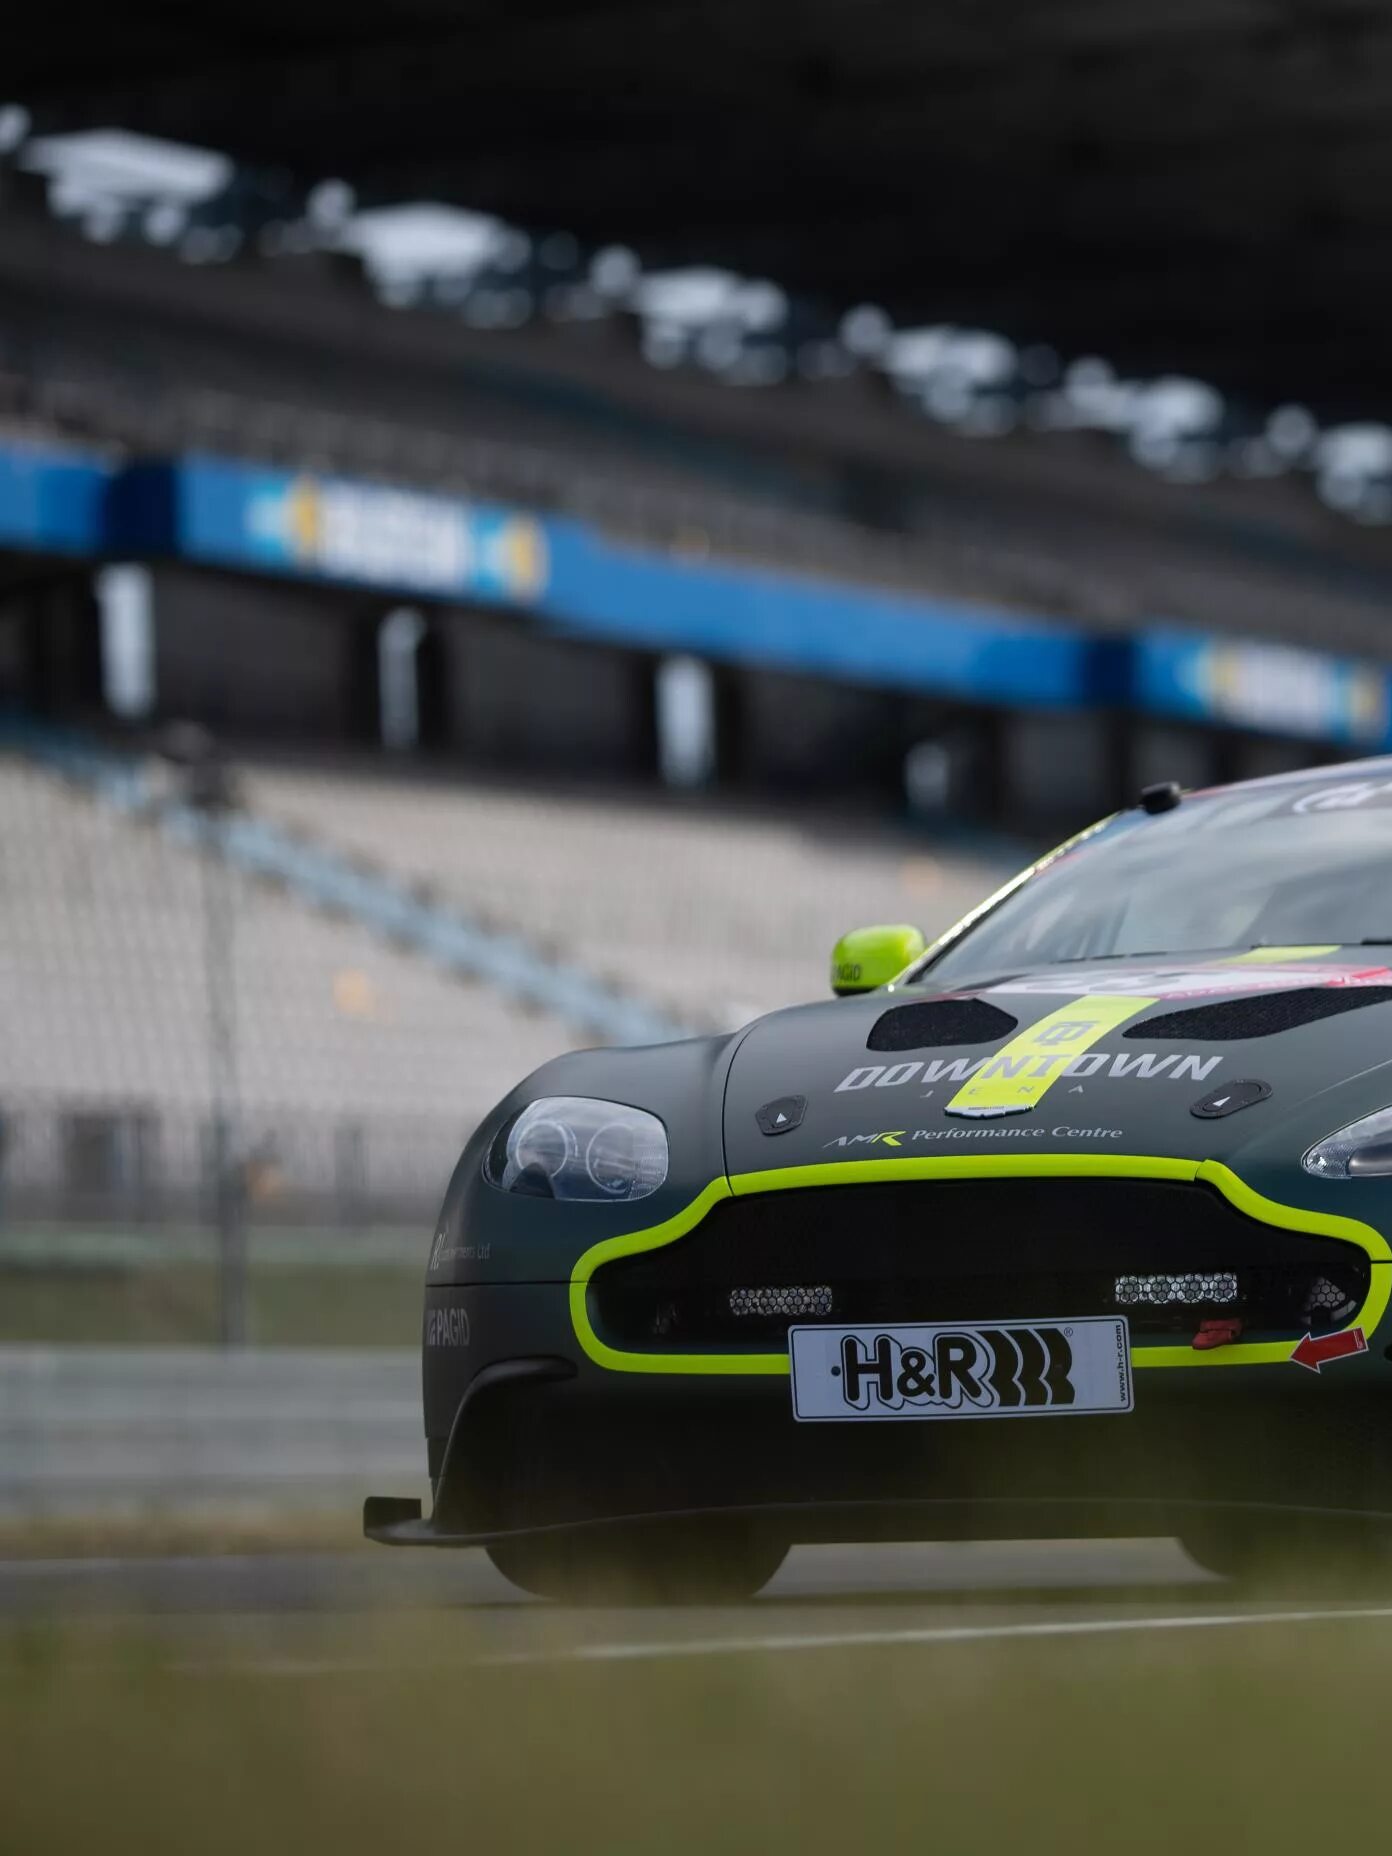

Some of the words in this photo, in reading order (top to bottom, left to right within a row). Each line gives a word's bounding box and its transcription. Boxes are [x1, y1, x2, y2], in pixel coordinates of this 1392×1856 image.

[834, 1053, 1224, 1093] DOWNTOWN
[822, 1131, 906, 1148] AMR
[911, 1127, 1045, 1141] Performance
[1051, 1126, 1123, 1139] Centre
[437, 1307, 471, 1346] PAGID
[841, 1332, 994, 1410] H&R
[1112, 1324, 1127, 1402] www.h-r.com
